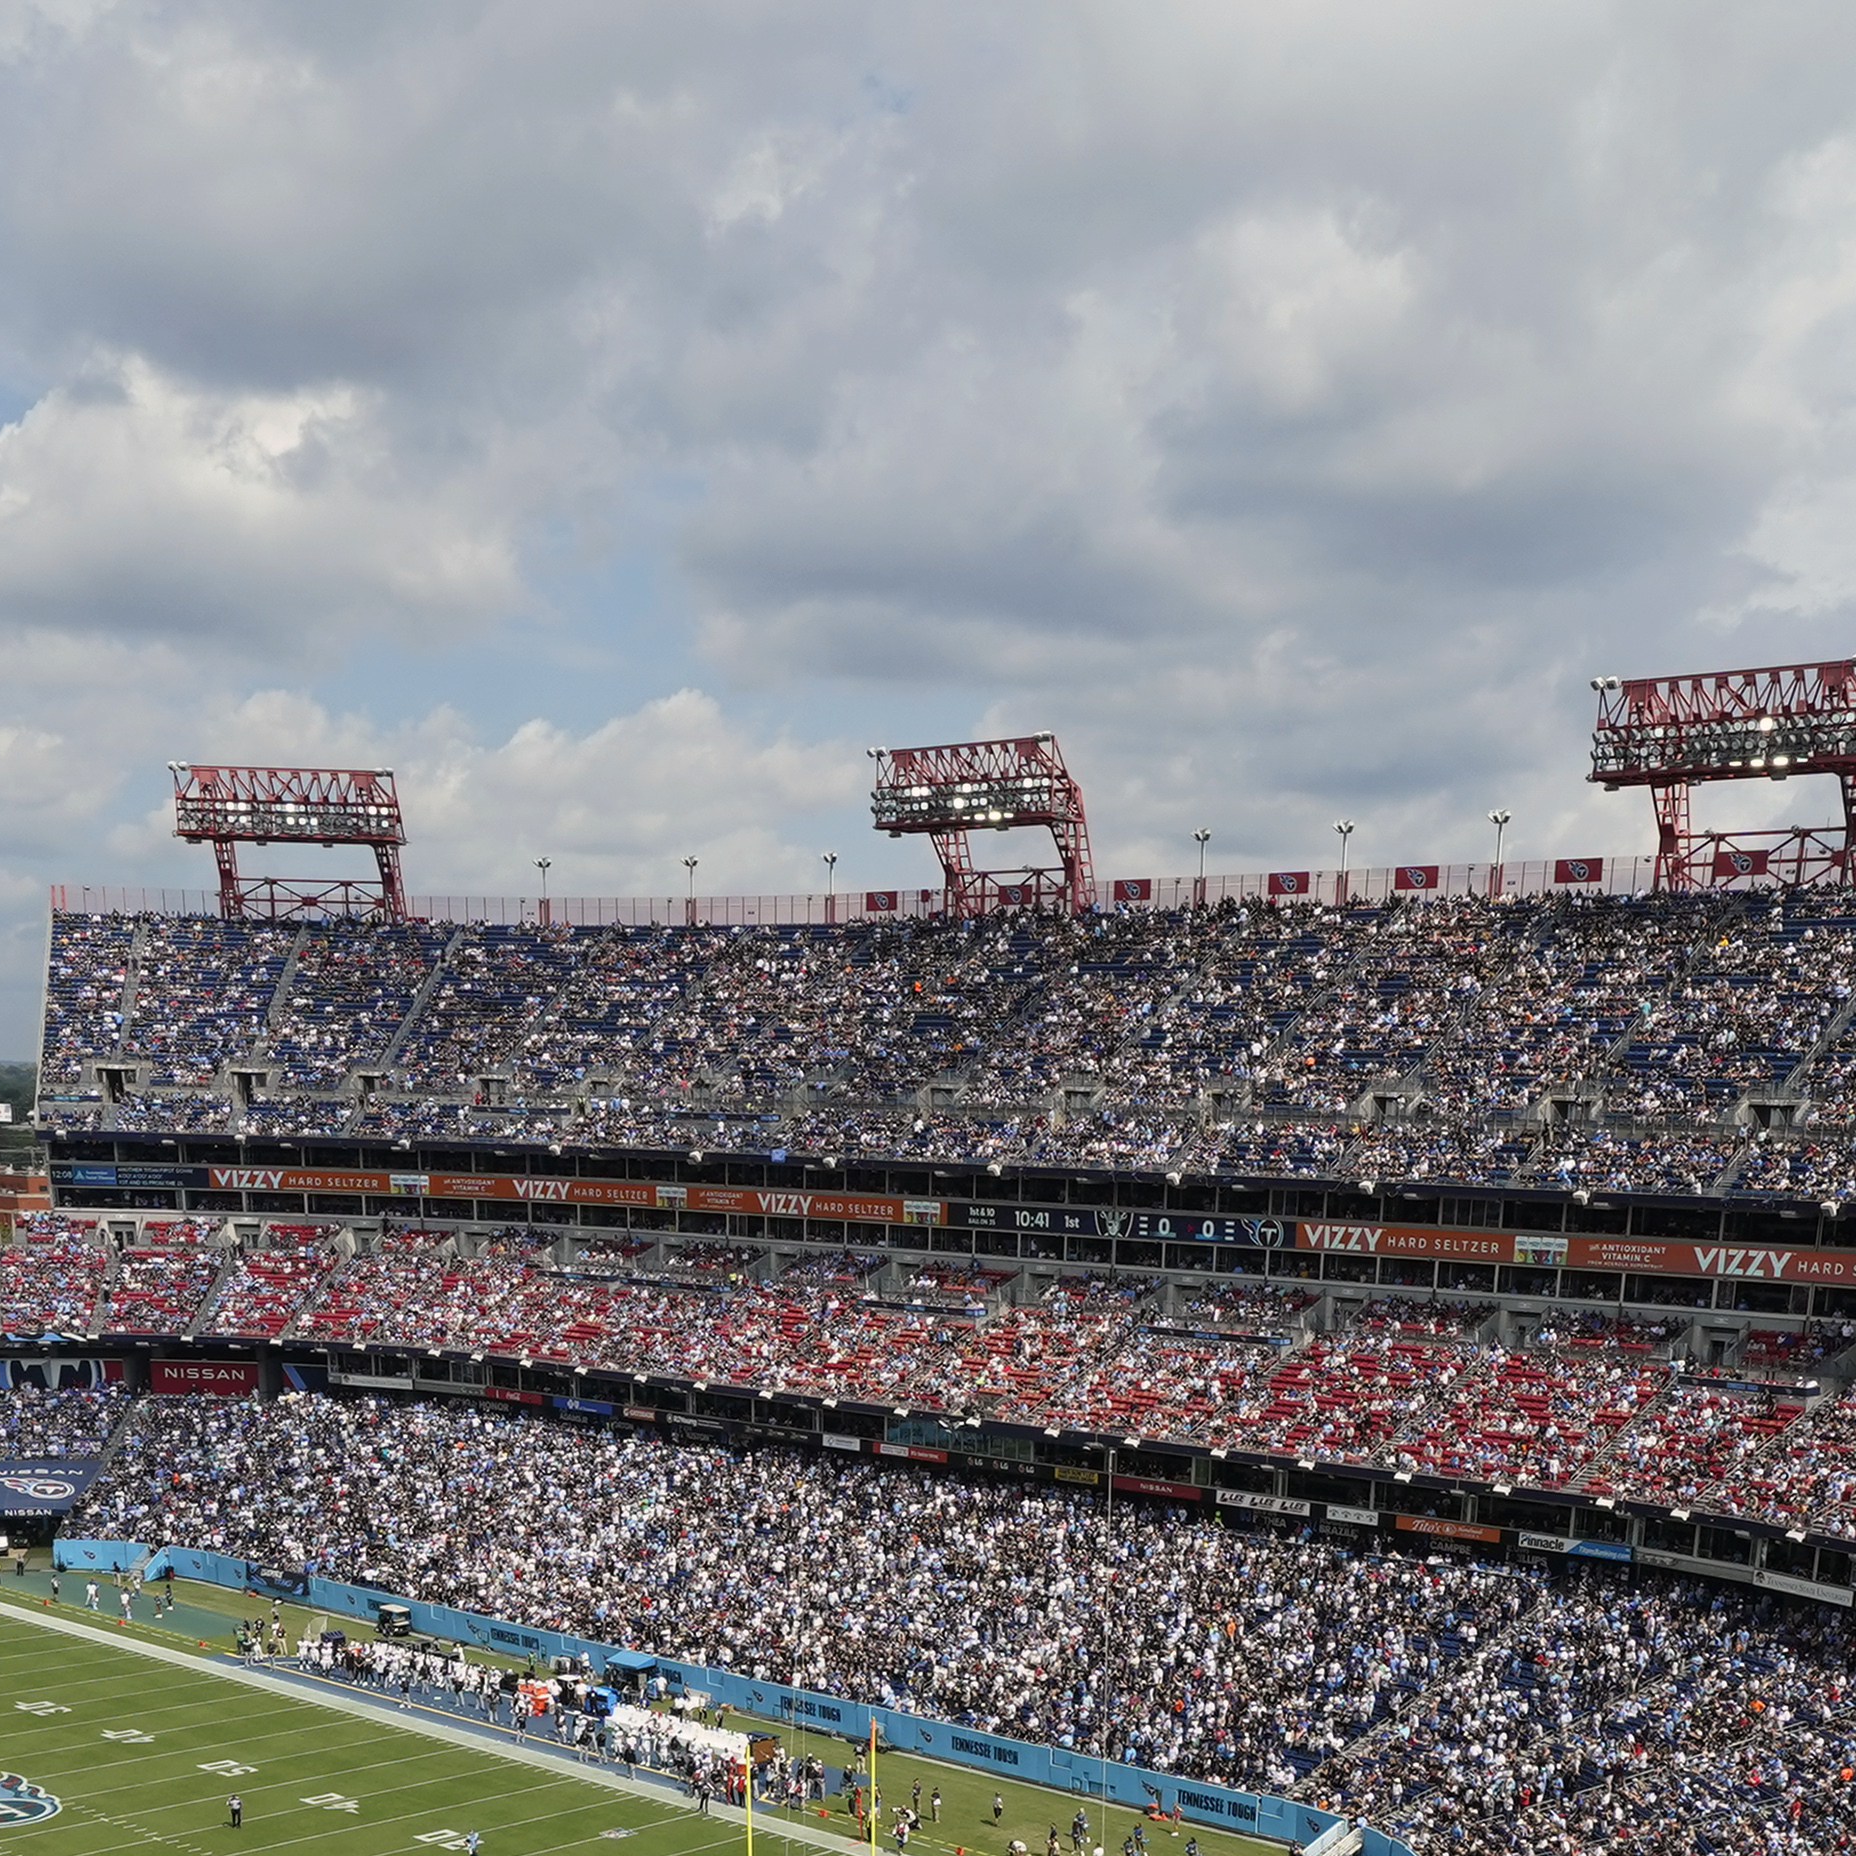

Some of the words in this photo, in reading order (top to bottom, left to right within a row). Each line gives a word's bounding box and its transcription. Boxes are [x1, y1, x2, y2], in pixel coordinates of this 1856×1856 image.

[214, 1169, 284, 1189] VIZZY
[289, 1177, 321, 1187] HARD
[328, 1178, 379, 1189] SELTZER
[757, 1192, 813, 1215] VIZZY
[815, 1201, 843, 1212] HARD
[848, 1203, 894, 1216] SELTZER
[1016, 1210, 1050, 1228] 10:41
[1064, 1213, 1081, 1228] 1st
[1158, 1217, 1171, 1235] 0
[1201, 1220, 1214, 1239] 0
[1303, 1224, 1383, 1251] VIZZY
[1387, 1236, 1427, 1249] HARD
[1434, 1239, 1500, 1254] SELTZER
[1601, 1243, 1667, 1255] ANTIOXIDANT
[1602, 1252, 1641, 1263] VITAMIN
[1644, 1254, 1651, 1264] C
[1693, 1246, 1793, 1278] VIZZY
[1797, 1261, 1844, 1276] HARD
[164, 1366, 246, 1381] NISSAN
[1139, 1482, 1173, 1494] NISSAN
[4, 1508, 52, 1517] NISSAN
[1411, 1519, 1441, 1534] Tito's
[1520, 1534, 1565, 1552] Pinnacle
[950, 1736, 991, 1758] TENNESSEE
[993, 1746, 1019, 1766] TOUGH
[1178, 1787, 1225, 1816] TENNESSEE
[1227, 1801, 1257, 1823] TOUGH
